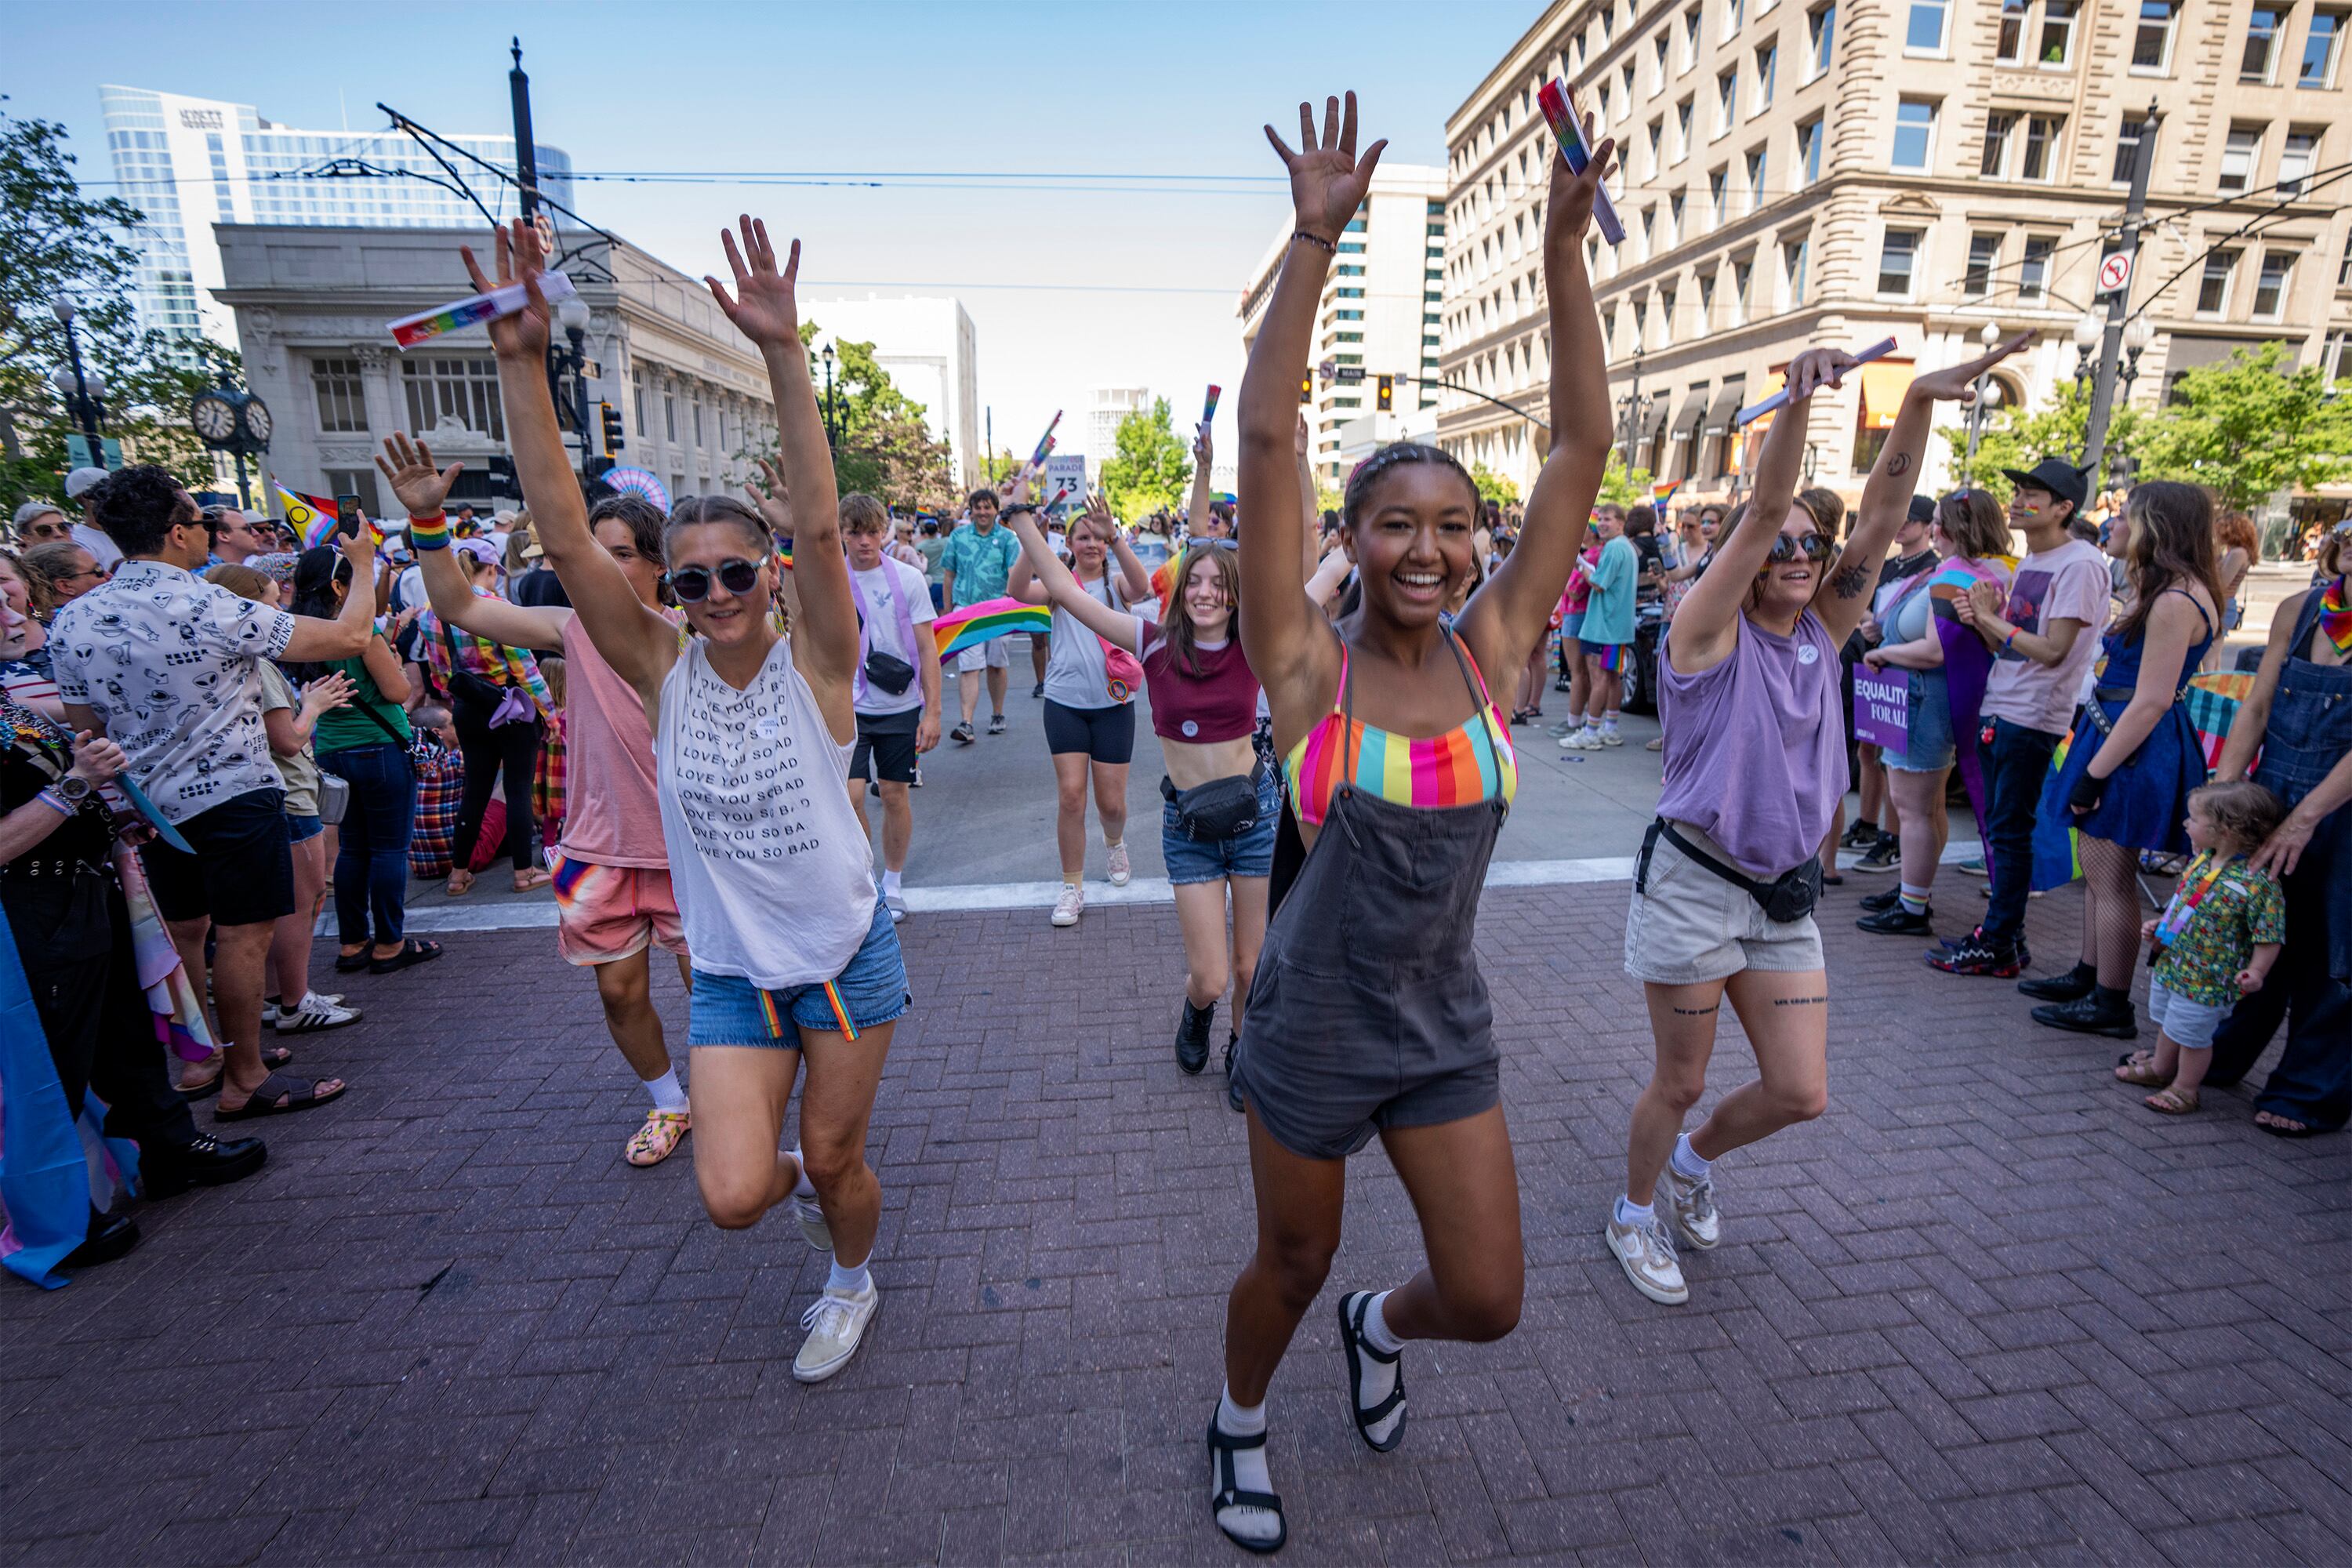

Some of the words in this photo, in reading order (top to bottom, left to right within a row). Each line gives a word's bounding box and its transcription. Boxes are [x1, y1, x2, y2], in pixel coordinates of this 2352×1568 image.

[1048, 463, 1083, 472] PARADE
[1055, 477, 1077, 492] 73
[165, 649, 209, 659] NEVER
[167, 656, 202, 666] LOOK
[1855, 678, 1907, 706] EQUALITY
[1871, 702, 1891, 724] FOR
[1891, 708, 1907, 729] ALL
[684, 746, 720, 764] LOVE
[753, 748, 772, 760] SO
[775, 736, 792, 750] AD
[677, 767, 715, 784] LOVE
[722, 774, 749, 787] YOU
[755, 768, 774, 780] SO
[774, 757, 798, 773] AD
[179, 780, 221, 793] NEVER
[180, 787, 213, 799] LOOK
[719, 793, 750, 806] YOU
[773, 777, 804, 795] BAD
[723, 811, 753, 822] YOU
[724, 829, 754, 842] YOU
[761, 827, 780, 839] SO
[785, 821, 805, 837] BA
[725, 848, 756, 861] YOU
[763, 847, 782, 859] SO
[788, 838, 820, 856] BAD
